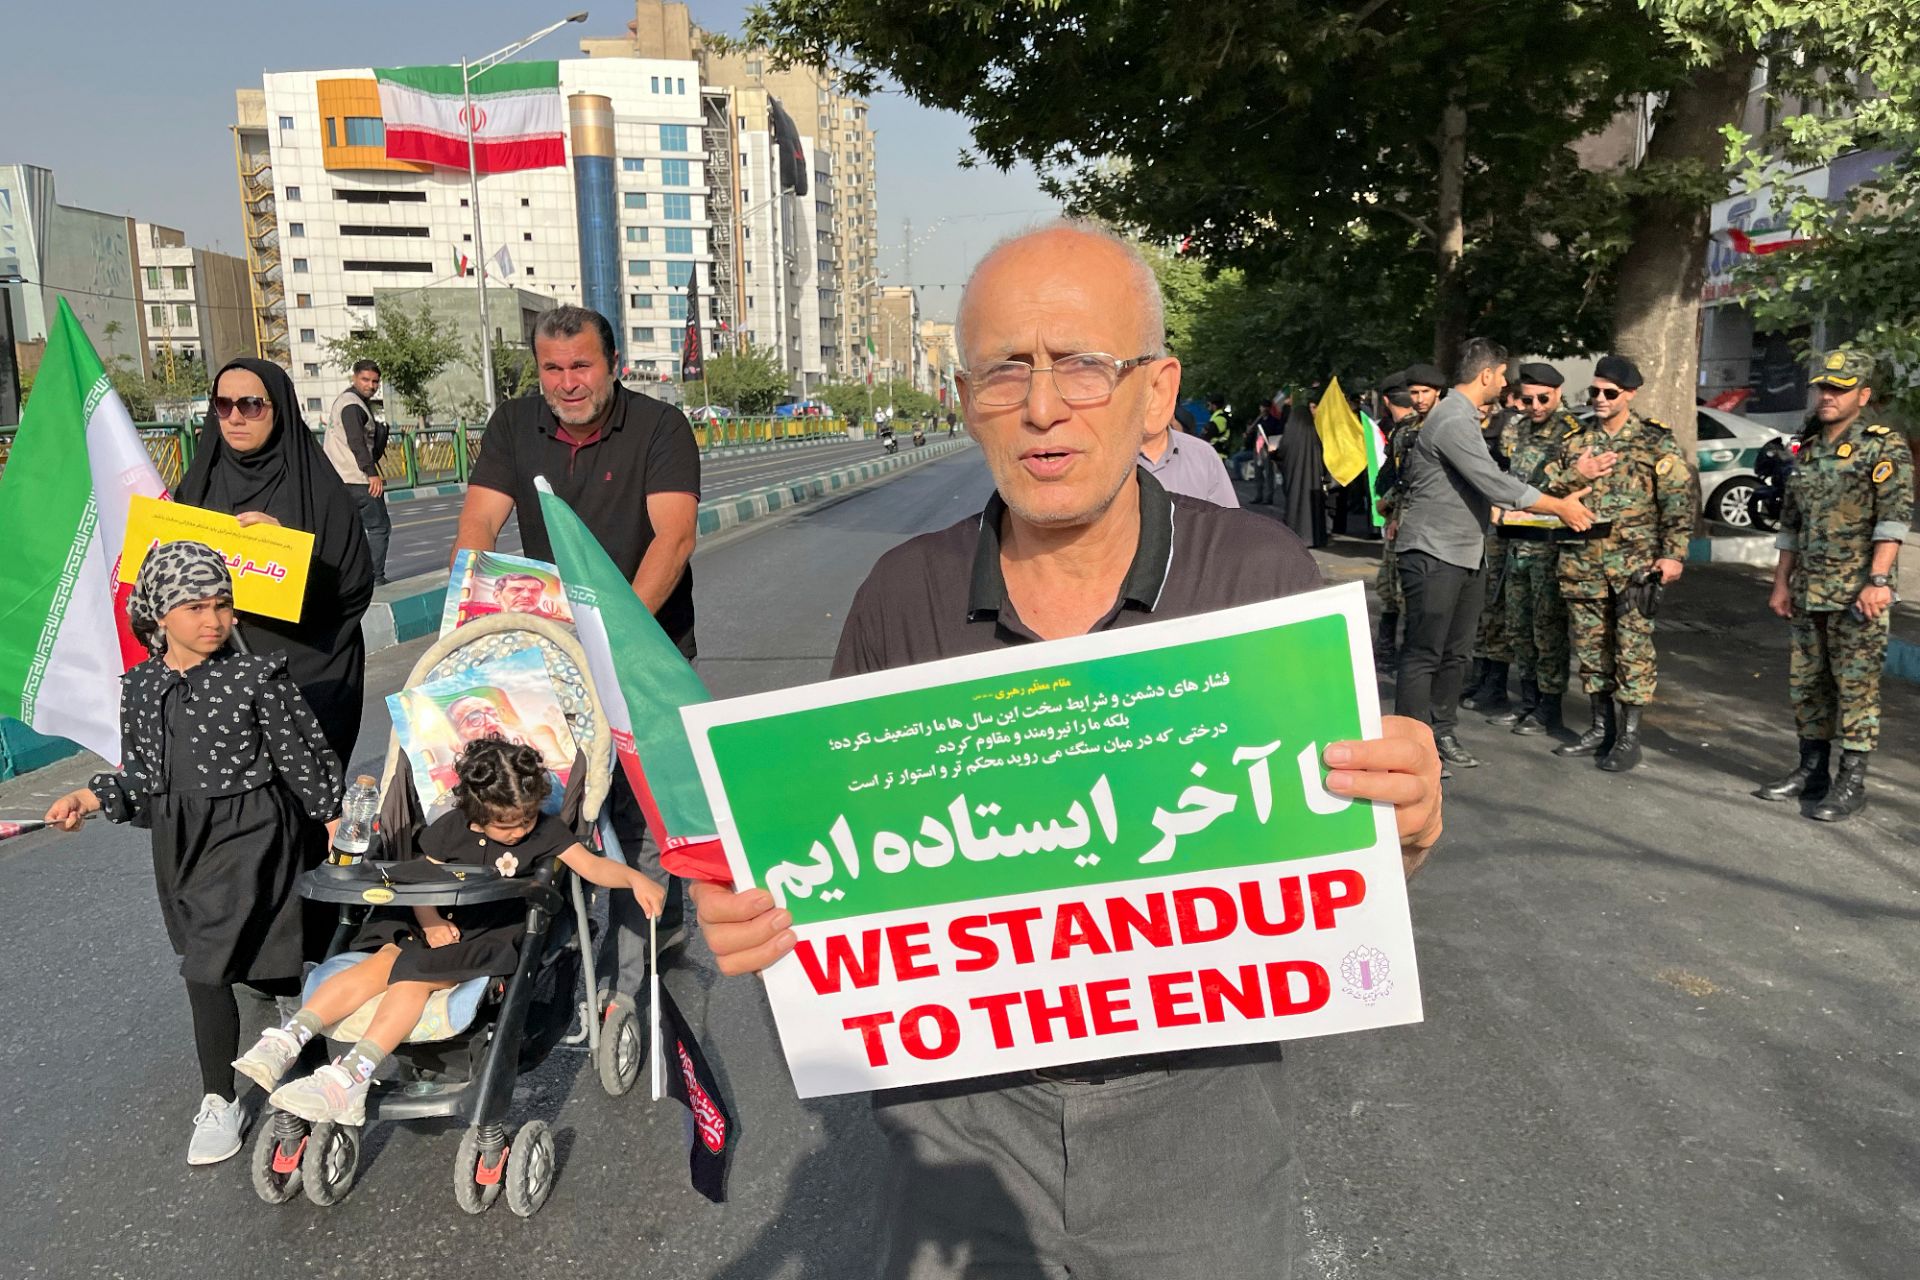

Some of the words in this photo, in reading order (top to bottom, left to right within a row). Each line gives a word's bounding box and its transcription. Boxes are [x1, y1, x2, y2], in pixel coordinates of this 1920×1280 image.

[1168, 679, 1198, 698] های
[1202, 671, 1230, 692] فشار
[1066, 692, 1108, 712] شرایط
[1111, 693, 1119, 708] و
[1122, 685, 1165, 707] دشمن
[996, 706, 1019, 726] این
[1022, 701, 1062, 718] سخت
[932, 719, 946, 731] ما
[947, 717, 963, 729] ها
[966, 712, 993, 731] سال
[1088, 717, 1101, 731] ما
[1103, 713, 1130, 729] بلکه
[1014, 731, 1022, 745] و
[1024, 721, 1072, 740] نیرومند
[1156, 728, 1174, 742] که
[1179, 722, 1228, 744] درختی
[976, 731, 1011, 752] مقاوم
[1065, 740, 1101, 756] سنگ
[1103, 736, 1133, 753] میان
[1136, 734, 1153, 749] در
[1007, 752, 1039, 767] روید
[1042, 748, 1063, 764] می
[899, 764, 937, 785] استوار
[940, 765, 948, 779] و
[951, 760, 962, 778] تر
[966, 756, 1005, 776] محکم
[848, 774, 879, 792] است
[884, 772, 894, 789] تر
[1138, 740, 1282, 864] آخر
[873, 773, 1118, 874] ایستاده
[765, 813, 860, 909] ایم
[793, 921, 940, 996] WE
[841, 1003, 961, 1067] TO
[968, 978, 1139, 1049] THE
[1148, 959, 1331, 1028] END
